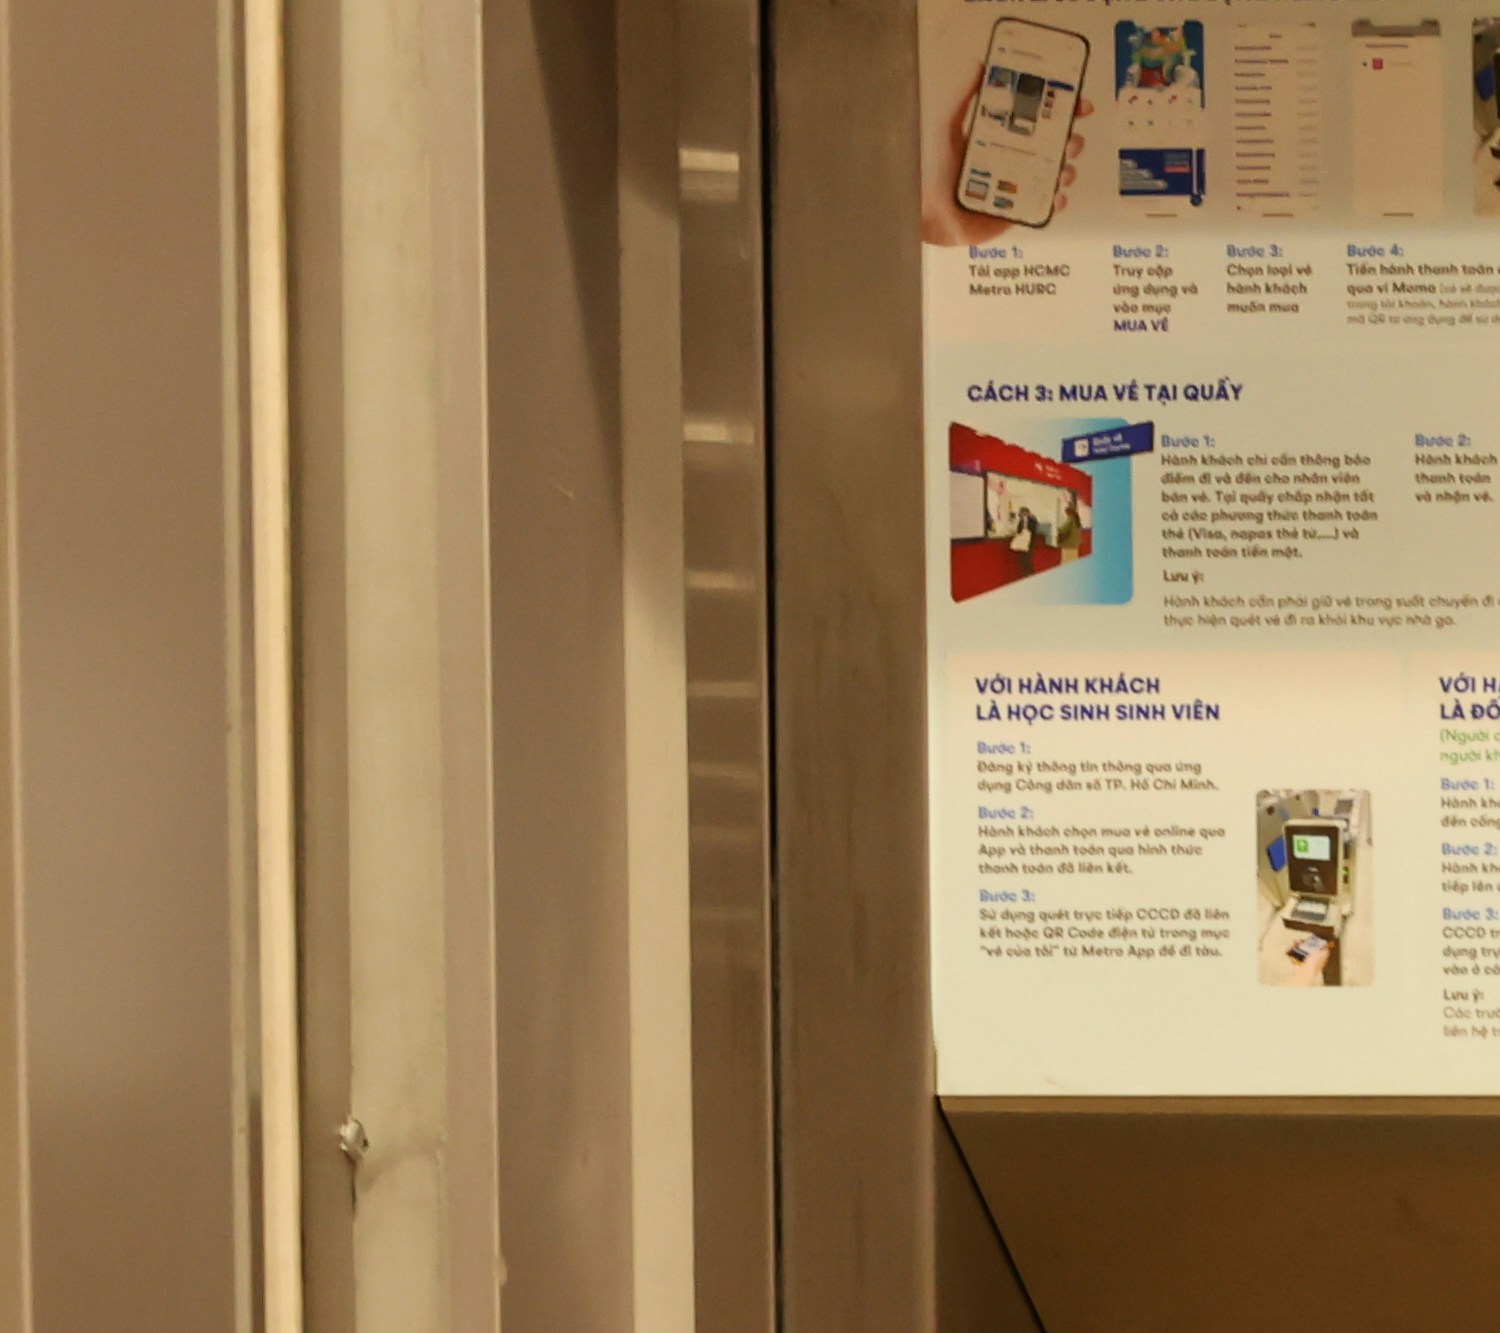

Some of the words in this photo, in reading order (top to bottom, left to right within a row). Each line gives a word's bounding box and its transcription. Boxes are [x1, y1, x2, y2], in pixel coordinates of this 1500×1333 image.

[967, 380, 1029, 402] CÁCH
[1035, 384, 1053, 402] 3:
[1059, 384, 1108, 402] MUA
[1112, 379, 1139, 401] VÉ
[1144, 384, 1177, 406] TẠI
[1183, 376, 1243, 402] QUẦY
[975, 673, 1012, 694] VỚI
[1018, 673, 1078, 694] HÀNH
[1085, 673, 1160, 694] KHÁCH
[976, 700, 1001, 721] LÀ
[1007, 704, 1054, 725] HỌC
[1060, 704, 1110, 721] SINH
[1115, 704, 1165, 721] SINH
[1171, 699, 1219, 720] VIÊN
[1440, 698, 1466, 720] LÀ
